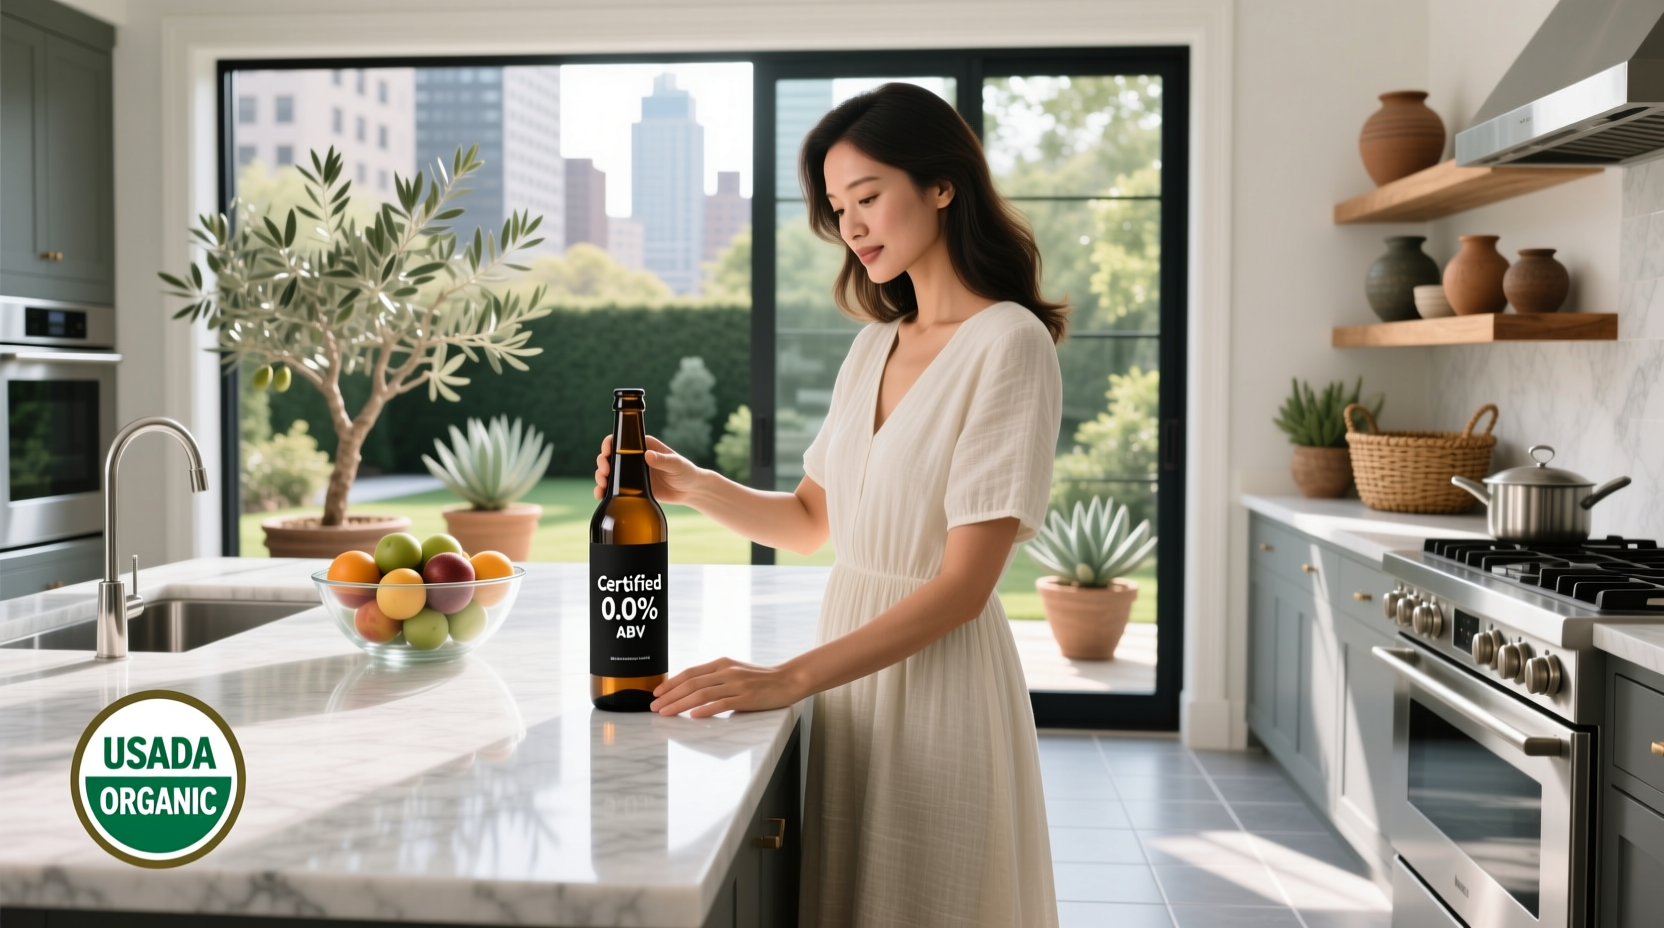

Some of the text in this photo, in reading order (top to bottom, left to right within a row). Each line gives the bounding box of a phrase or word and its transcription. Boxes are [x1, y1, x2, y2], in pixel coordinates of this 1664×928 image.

[597, 573, 662, 592] Certified
[601, 596, 658, 621] 0.0%
[616, 625, 646, 639] ABV
